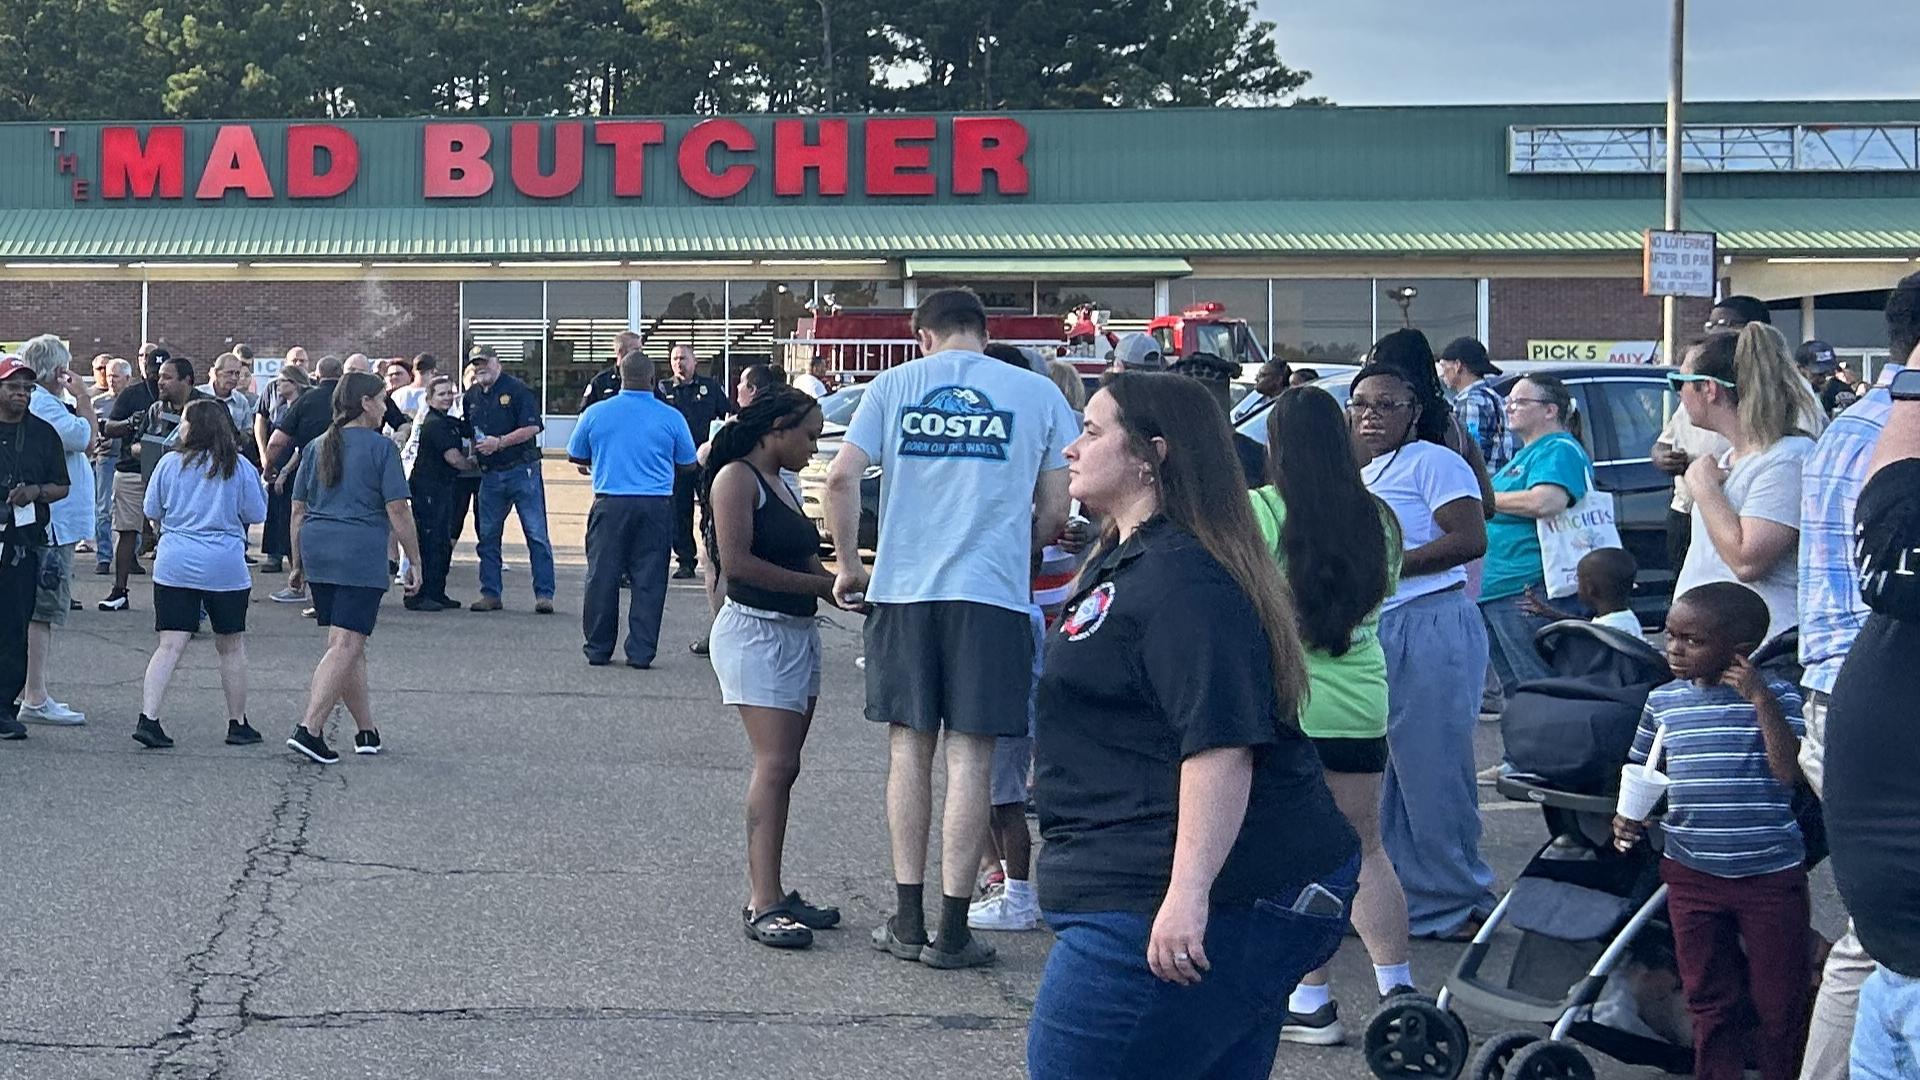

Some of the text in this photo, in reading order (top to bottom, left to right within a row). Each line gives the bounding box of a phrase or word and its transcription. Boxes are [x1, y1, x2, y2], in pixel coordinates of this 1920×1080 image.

[50, 117, 1029, 200] THE MAD BUTCHER
[1533, 345, 1597, 360] PICK 5
[1609, 353, 1645, 364] MIX
[902, 411, 1007, 439] COSTA
[930, 442, 945, 453] ON
[947, 442, 965, 454] THE
[966, 443, 999, 455] WATER
[1548, 509, 1614, 534] TEACHERS
